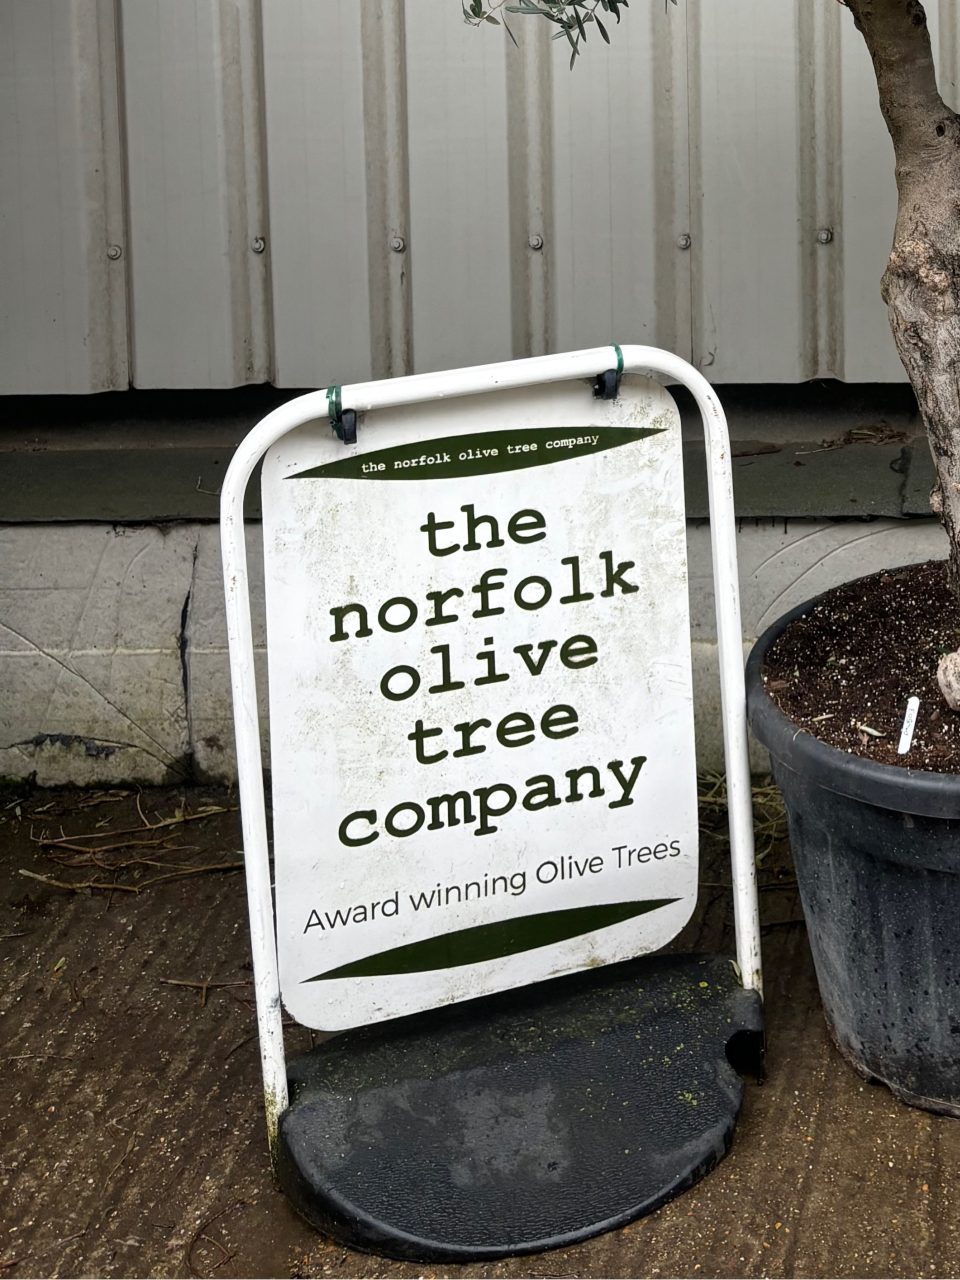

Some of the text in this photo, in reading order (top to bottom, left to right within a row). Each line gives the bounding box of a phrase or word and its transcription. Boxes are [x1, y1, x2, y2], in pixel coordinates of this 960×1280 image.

[361, 433, 600, 473] the norfolk olive tree company
[421, 504, 547, 557] the
[329, 551, 640, 643] norfolk
[380, 635, 599, 702] olive
[408, 704, 579, 765] tree
[338, 756, 647, 848] company
[303, 836, 682, 934] Award winning Olive Trees
